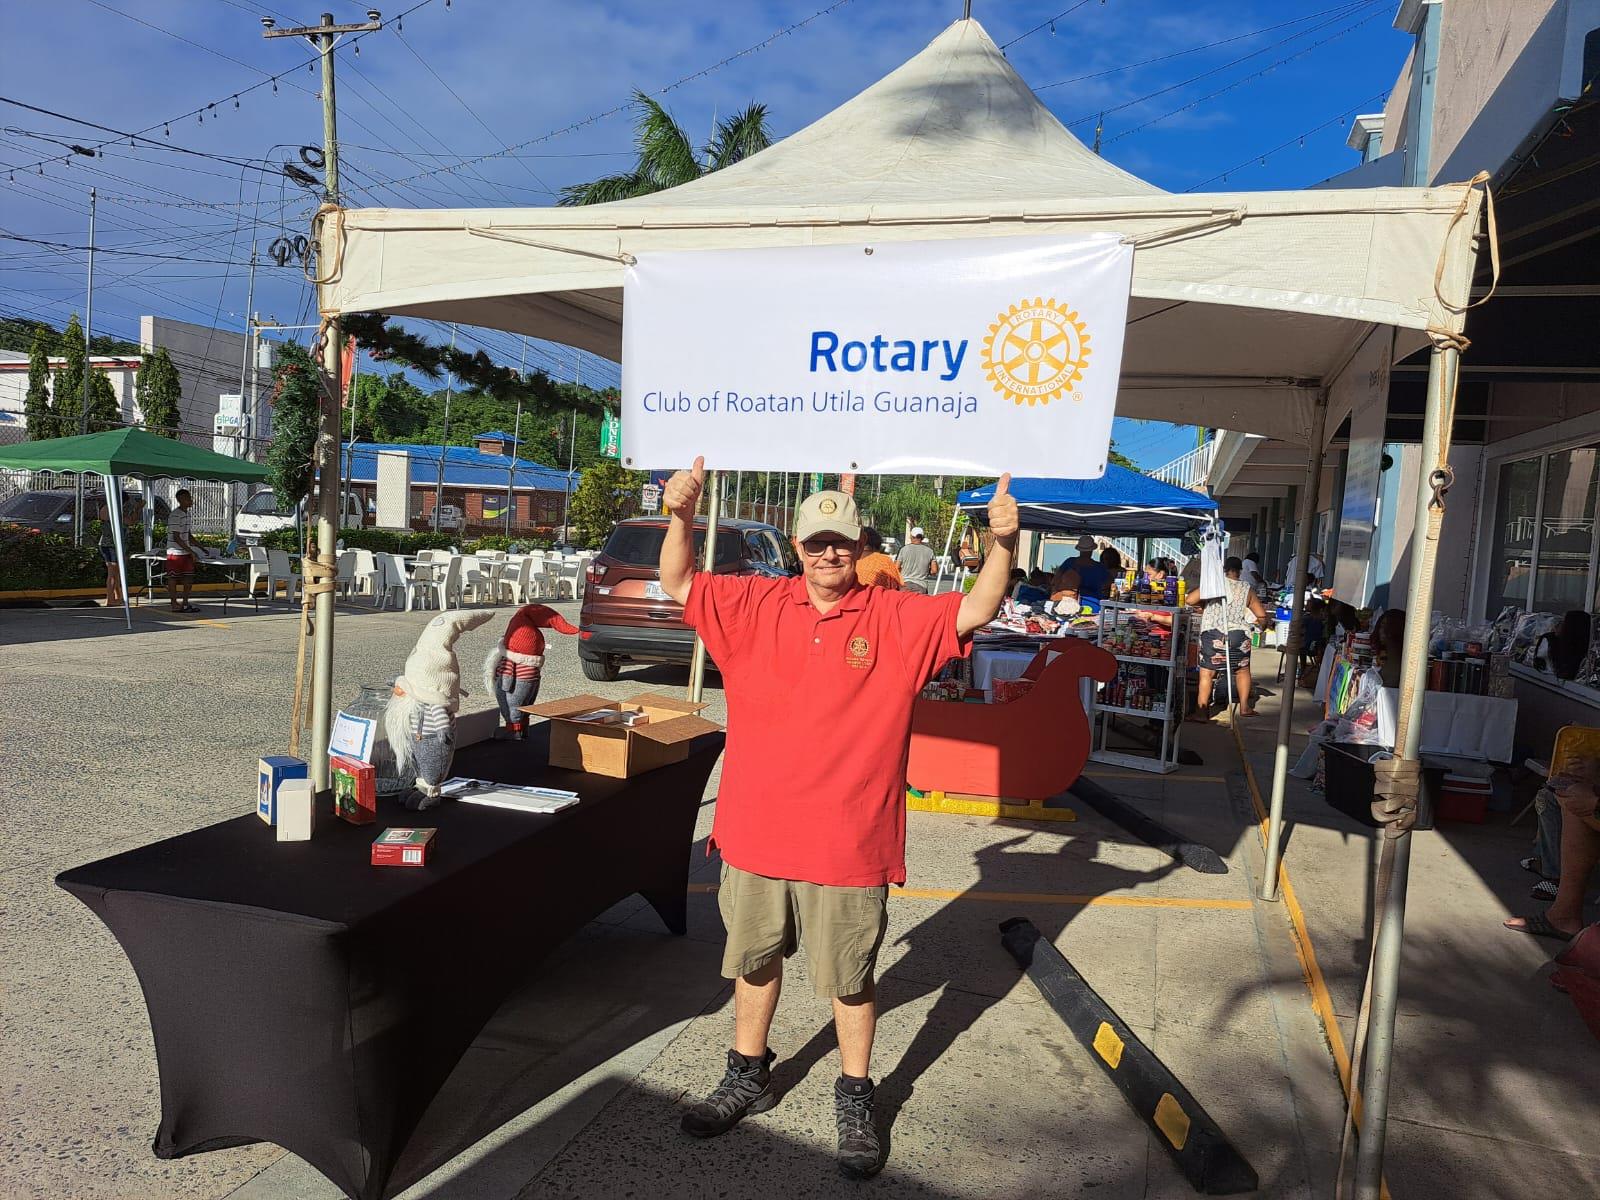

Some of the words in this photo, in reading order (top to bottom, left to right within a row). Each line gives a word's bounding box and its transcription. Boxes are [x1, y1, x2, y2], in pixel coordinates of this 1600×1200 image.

[1015, 310, 1060, 322] ROTARY
[809, 330, 969, 382] Rotary
[996, 366, 1074, 395] INTERNATIONAL
[643, 390, 691, 413] Club
[697, 390, 721, 413] of
[726, 391, 804, 413] Roatan
[812, 390, 865, 413] Utila
[873, 391, 978, 420] Guanaja
